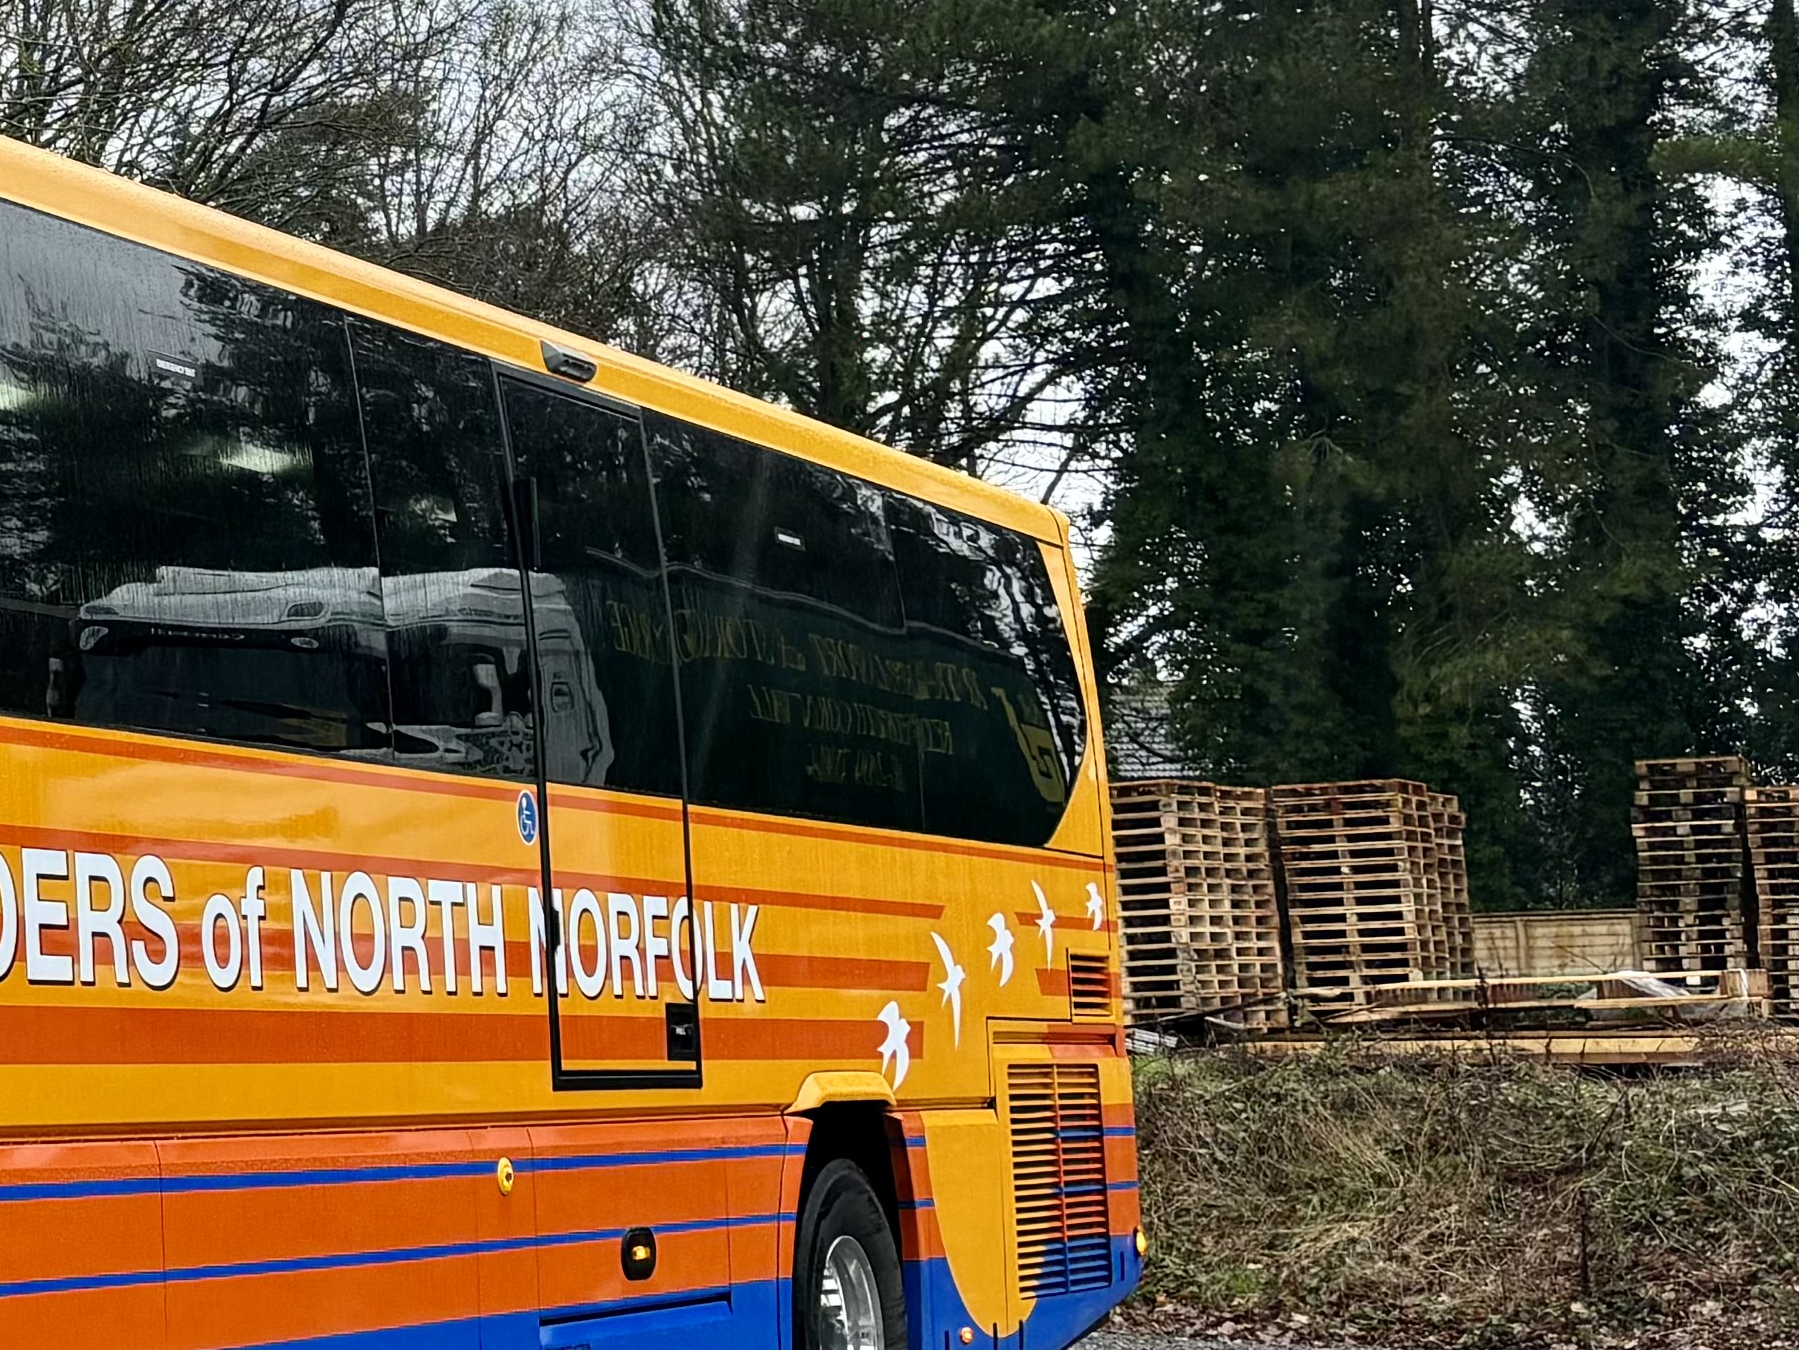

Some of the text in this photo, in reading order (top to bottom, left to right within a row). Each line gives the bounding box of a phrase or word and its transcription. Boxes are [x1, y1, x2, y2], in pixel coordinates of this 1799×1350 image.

[201, 864, 266, 992] of
[291, 868, 509, 997] NORTH
[532, 884, 767, 1005] NORFOLK
